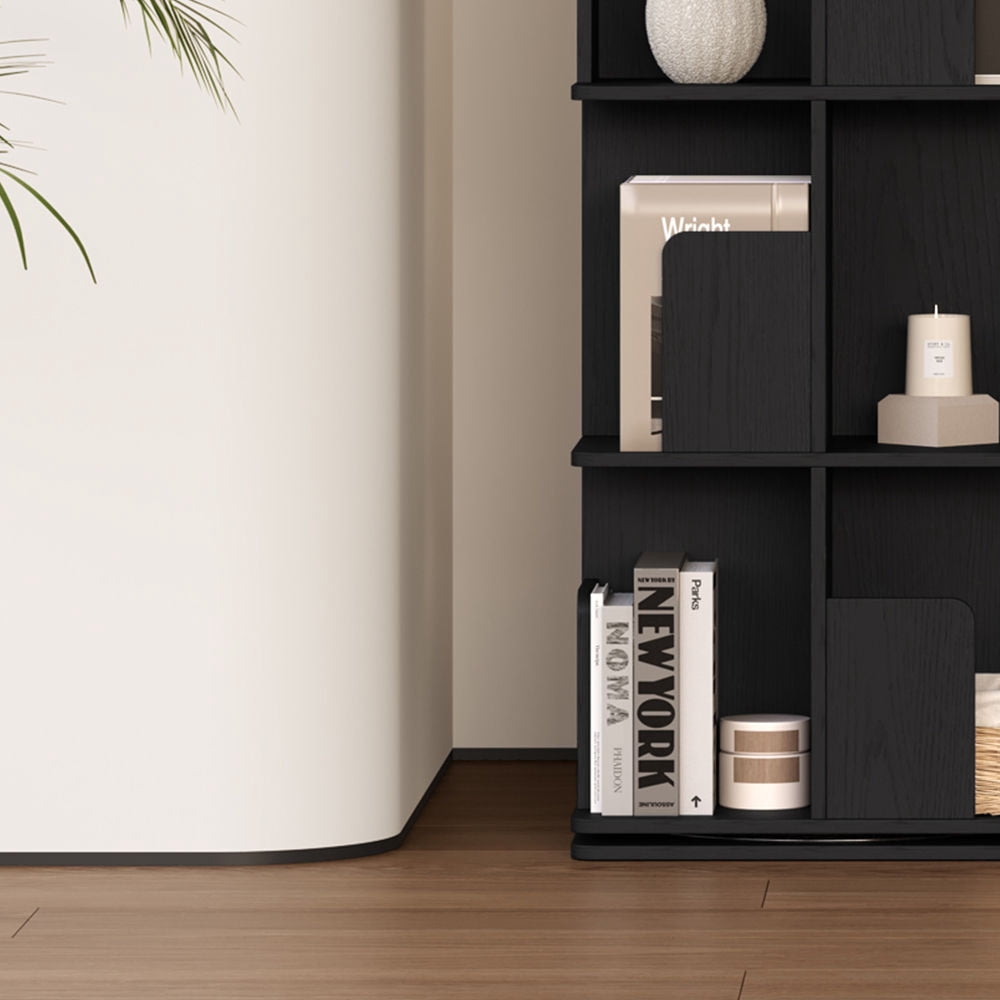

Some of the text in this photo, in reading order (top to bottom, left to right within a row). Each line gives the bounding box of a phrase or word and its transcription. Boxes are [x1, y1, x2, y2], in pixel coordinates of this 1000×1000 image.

[691, 579, 702, 611] Parks
[606, 622, 629, 726] NOMA
[637, 587, 675, 789] NEW YORK
[614, 747, 622, 793] PHAIDON
